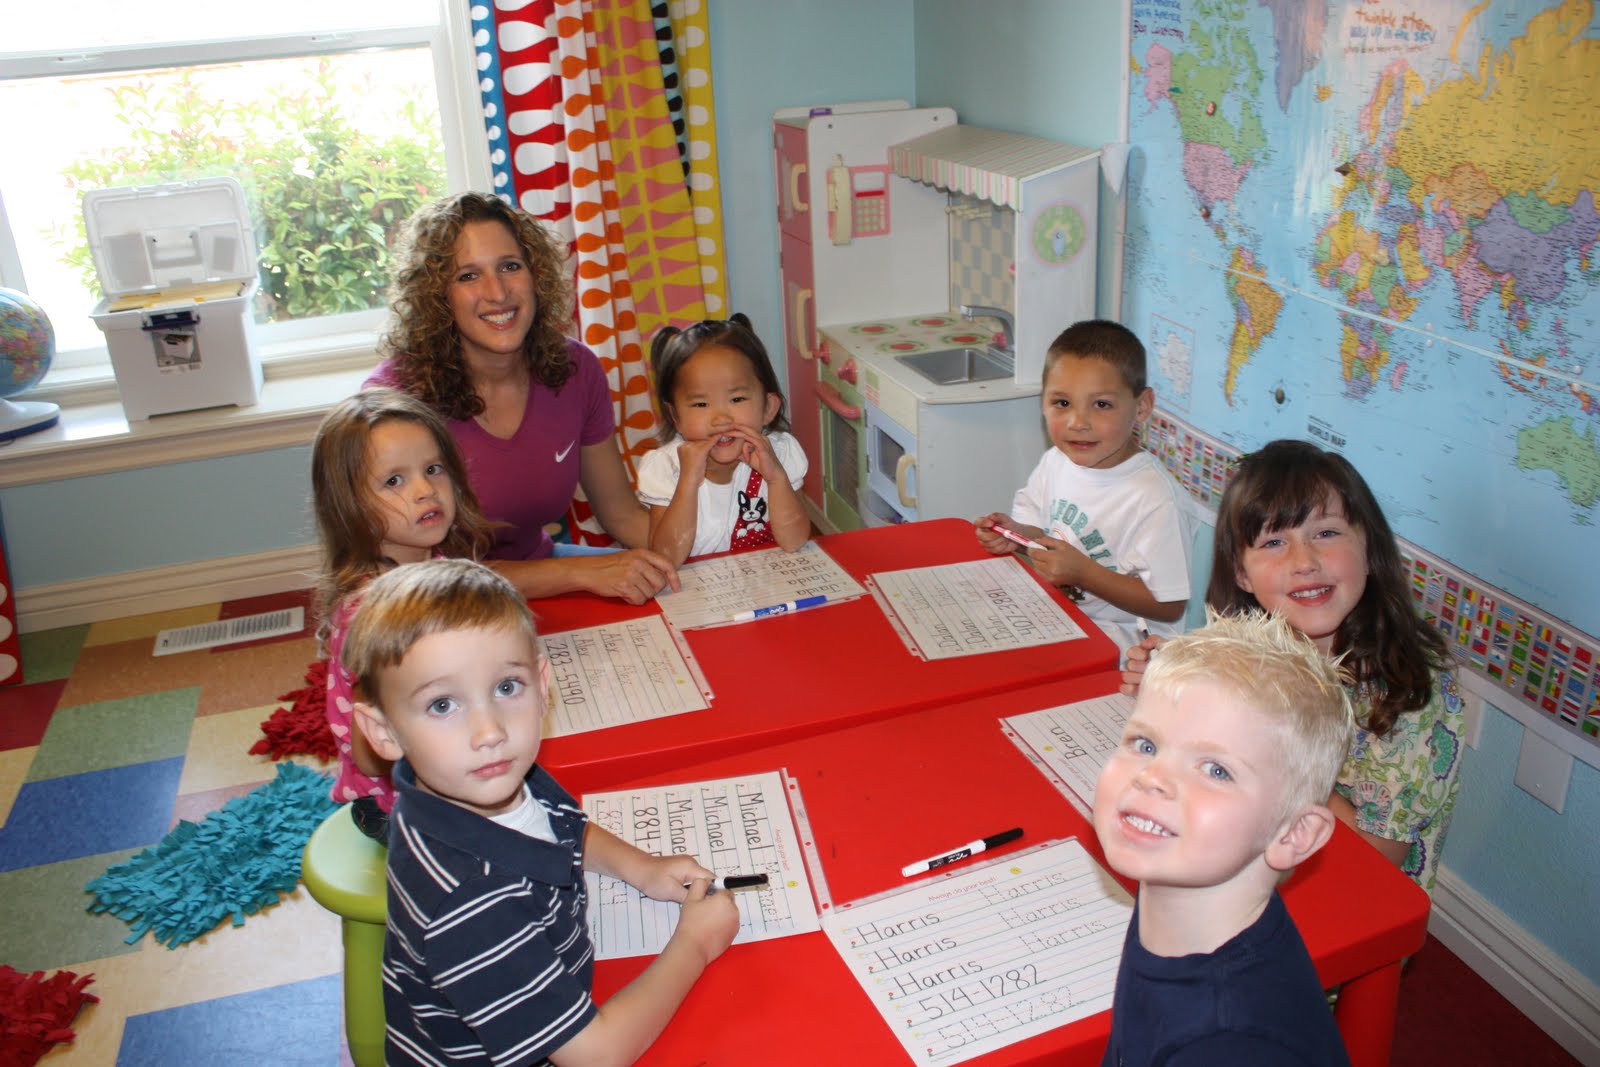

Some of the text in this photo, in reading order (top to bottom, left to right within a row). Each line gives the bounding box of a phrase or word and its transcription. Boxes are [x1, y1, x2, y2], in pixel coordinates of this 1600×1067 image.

[1331, 434, 1346, 447] MAP
[1050, 499, 1117, 570] FORNI
[547, 643, 586, 705] 283-5490
[1050, 726, 1087, 759] Bren
[667, 799, 700, 856] Michae
[704, 796, 736, 854] Michael
[739, 792, 774, 850] Michael
[857, 871, 1067, 944] Harris Harris
[874, 897, 1082, 970] Harris Harris
[893, 921, 1107, 996] Harris Harris
[919, 964, 1047, 1020] 514-1282
